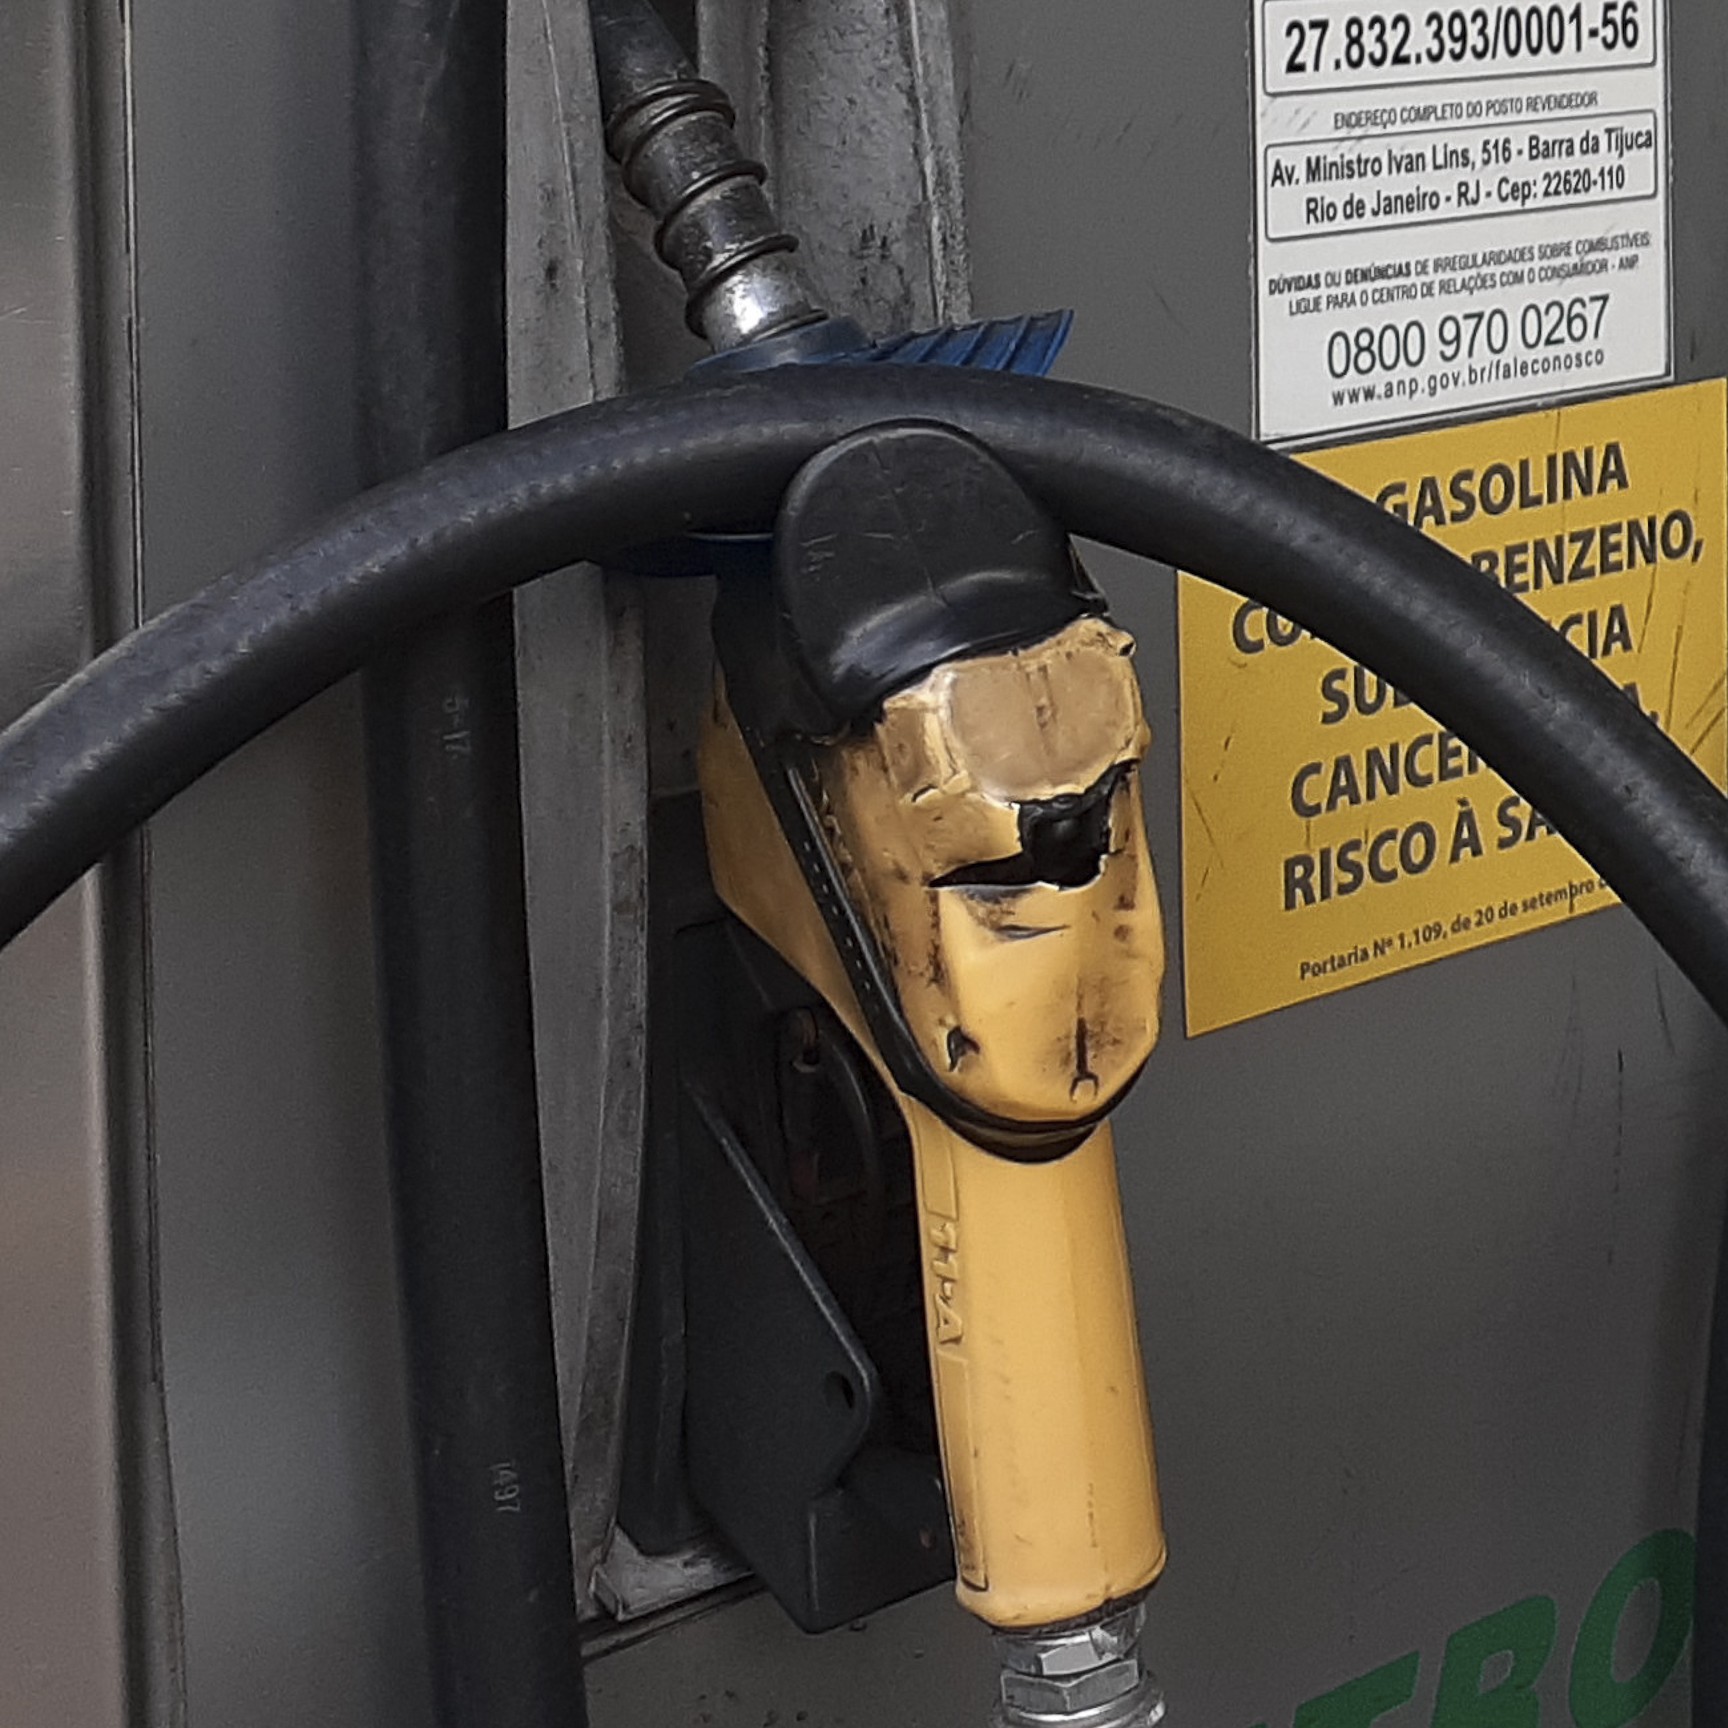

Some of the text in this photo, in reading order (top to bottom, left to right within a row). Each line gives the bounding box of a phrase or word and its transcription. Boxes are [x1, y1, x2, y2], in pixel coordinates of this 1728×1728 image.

[1284, 0, 1640, 75] 27.832.393/0001-56
[1334, 91, 1598, 130] ENDEREÇO COMPLETO DO POSTO REVENDEDOR
[1271, 159, 1299, 187] Av.
[1306, 153, 1382, 184] Ministro
[1388, 149, 1426, 175] Ivan
[1432, 143, 1475, 171] Lins,
[1482, 137, 1511, 166] 516
[1529, 135, 1574, 161] Barra
[1580, 130, 1599, 155] da
[1605, 125, 1653, 154] Tijuca
[1306, 196, 1337, 224] Rio
[1343, 193, 1365, 220] de
[1371, 185, 1440, 217] Janeiro
[1457, 179, 1480, 207] RJ
[1497, 176, 1537, 205] Cep:
[1543, 164, 1625, 198] 22620-110
[1269, 273, 1321, 296] DÚVIDAS
[1325, 271, 1341, 288] OU
[1345, 261, 1411, 285] DENÚNCIAS
[1415, 259, 1429, 276] DE
[1433, 246, 1534, 273] IRREGULARIDADES
[1538, 241, 1572, 261] SOBRE
[1289, 295, 1322, 316] LIGUE
[1326, 292, 1356, 310] PARA
[1360, 289, 1368, 307] O
[1372, 282, 1417, 306] CENTRO
[1422, 280, 1435, 298] DE
[1439, 272, 1497, 299] RELAÇÕES
[1500, 269, 1524, 287] COM
[1527, 267, 1535, 284] O
[1538, 258, 1608, 280] CONSUMIDOR
[1328, 294, 1609, 379] 0800 970 0267
[1332, 348, 1604, 408] www.anp.gov.br/faleconosco
[1375, 440, 1630, 531] GASOLINA
[1283, 819, 1437, 912] RISCO
[1449, 797, 1484, 865] À
[1300, 943, 1369, 981] Portaria
[1398, 923, 1448, 951] 1.109,
[1451, 914, 1472, 934] de
[1474, 904, 1494, 926] 20
[1498, 899, 1518, 920] de
